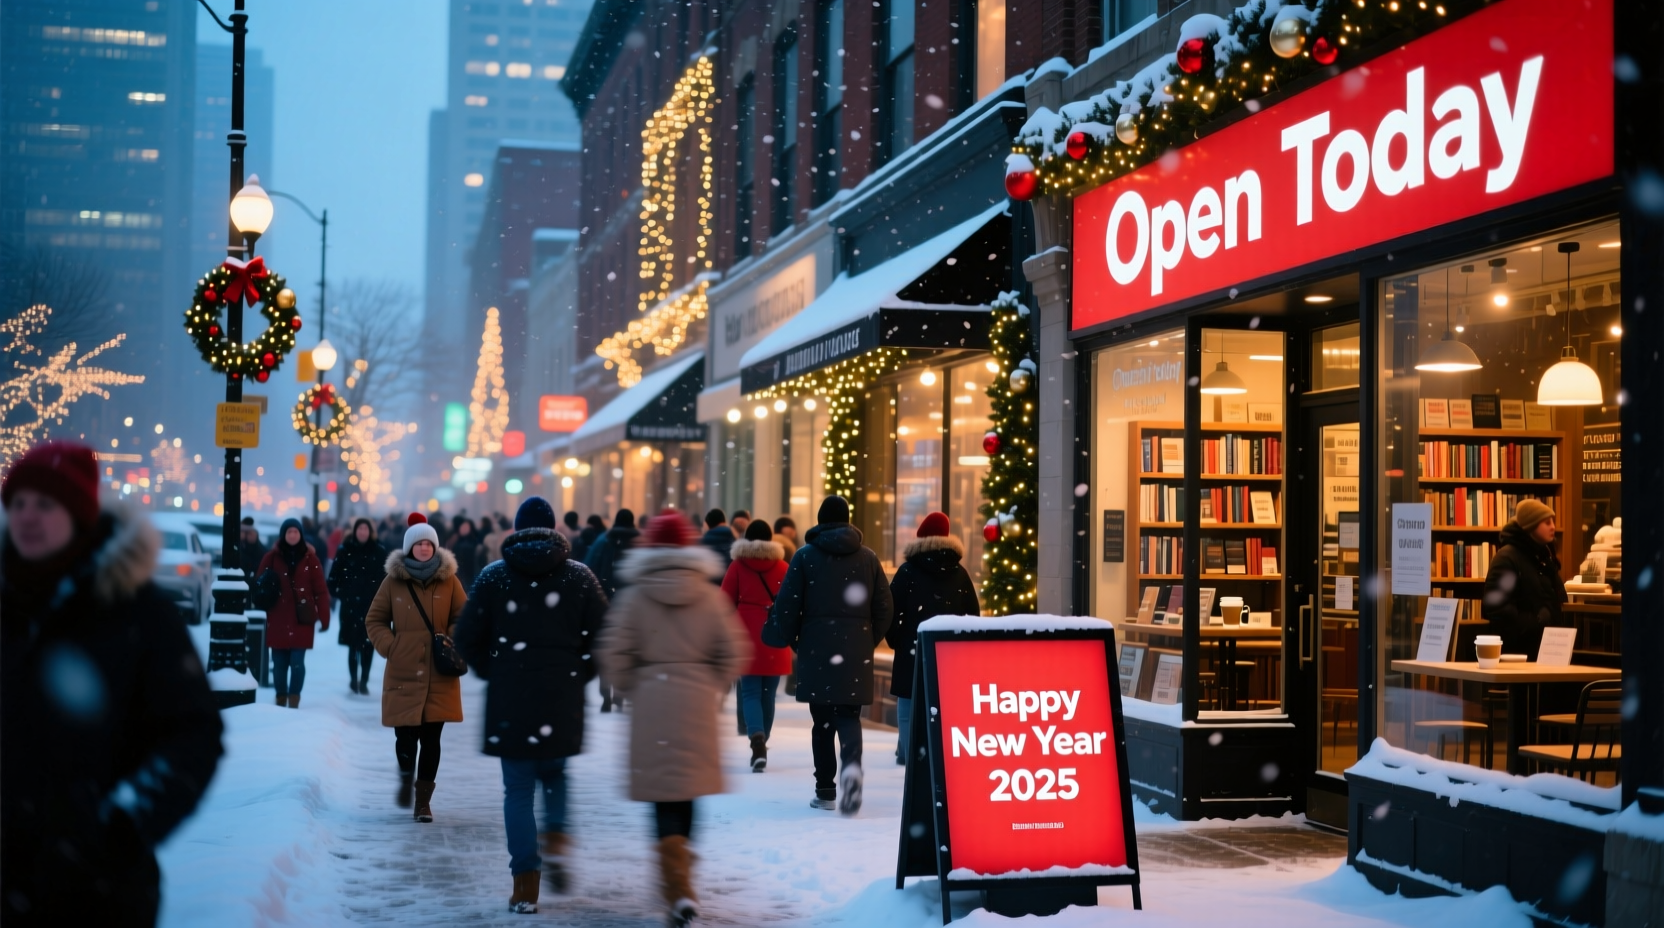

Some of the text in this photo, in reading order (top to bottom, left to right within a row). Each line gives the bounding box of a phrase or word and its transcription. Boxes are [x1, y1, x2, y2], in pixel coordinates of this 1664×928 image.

[1105, 55, 1544, 297] Open Today
[971, 683, 1081, 722] Happy
[951, 725, 1107, 758] New Year
[988, 767, 1080, 802] 2025
